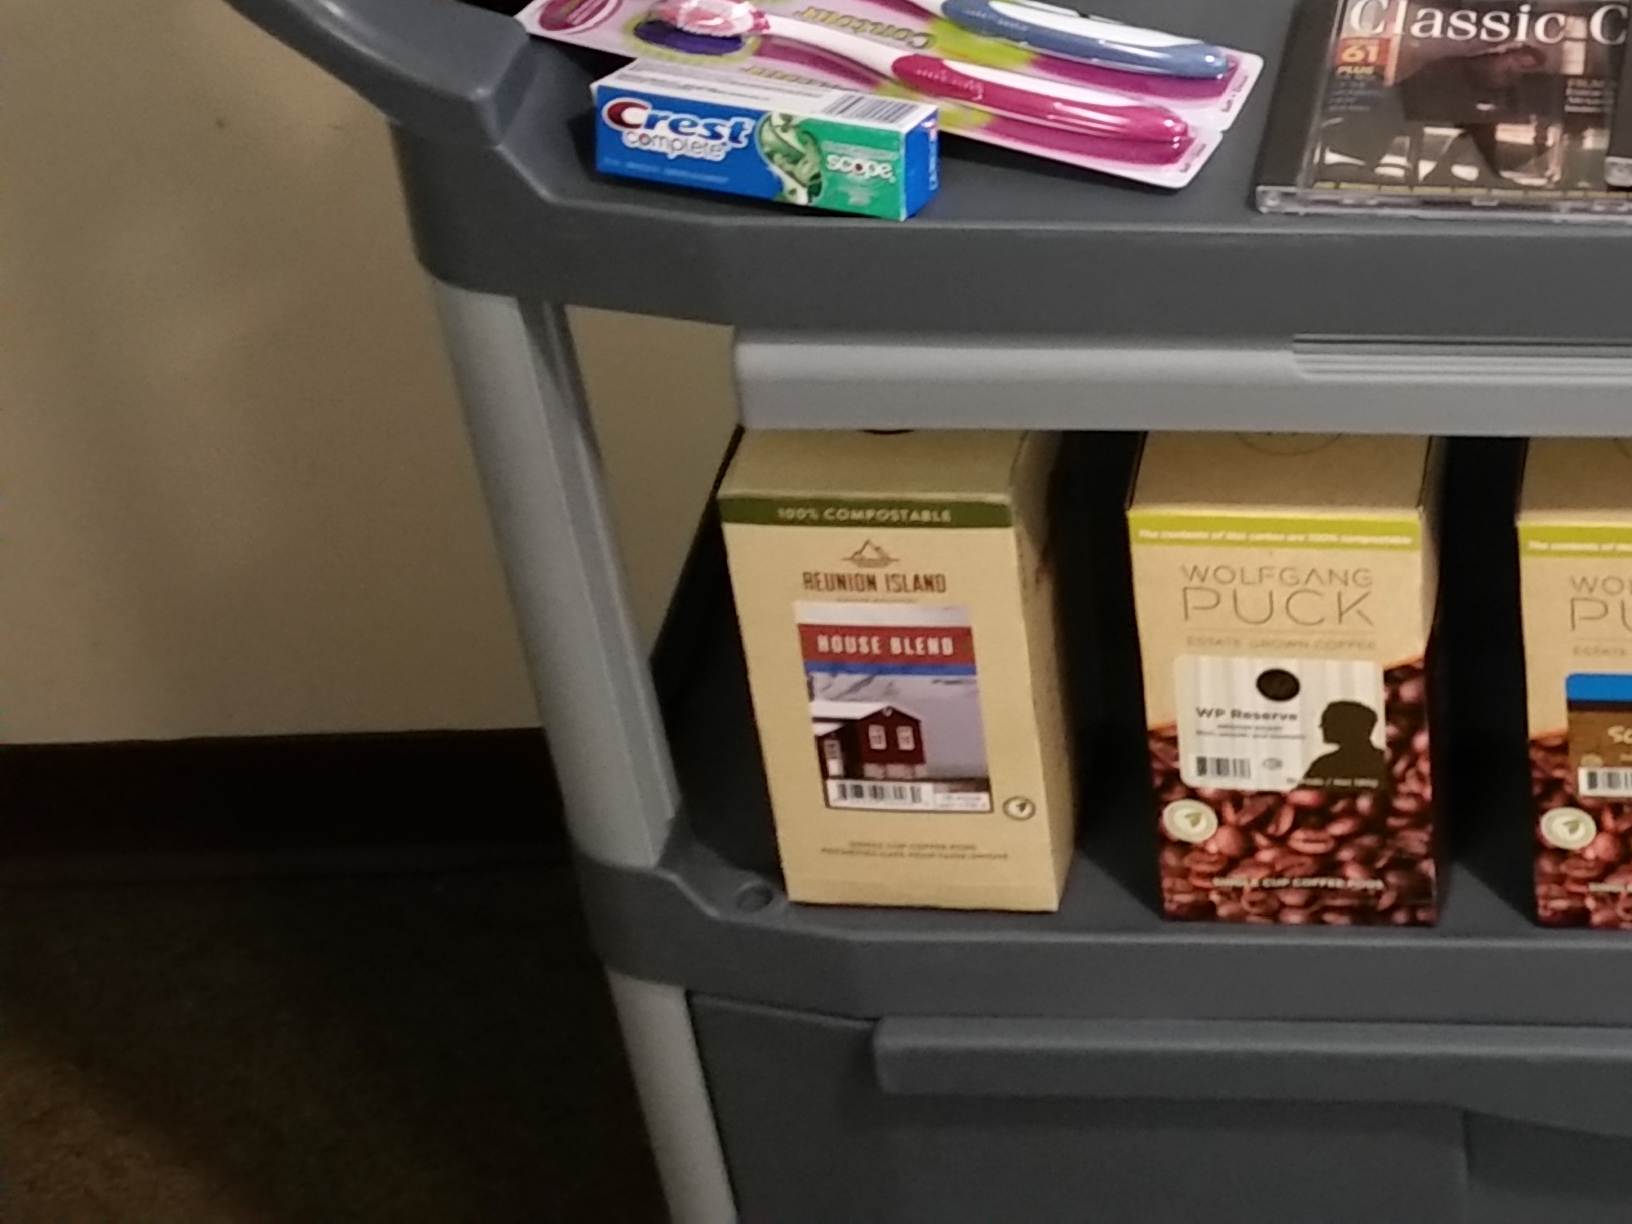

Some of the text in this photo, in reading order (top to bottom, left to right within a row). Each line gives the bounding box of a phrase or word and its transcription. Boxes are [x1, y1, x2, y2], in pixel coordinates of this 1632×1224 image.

[1341, 45, 1380, 63] 61
[604, 99, 756, 145] Crest
[626, 129, 726, 160] complete
[827, 155, 893, 180] scope
[778, 507, 952, 523] 100% COMPOSTABLE
[802, 571, 947, 594] REUNION ISLAND
[1180, 564, 1374, 588] WOLFGANG
[1182, 585, 1375, 627] PUCK
[817, 634, 954, 657] HOUSE BLEND
[1195, 707, 1298, 721] WP Reserve
[1262, 878, 1290, 888] CUP
[1292, 878, 1345, 888] COFFEE
